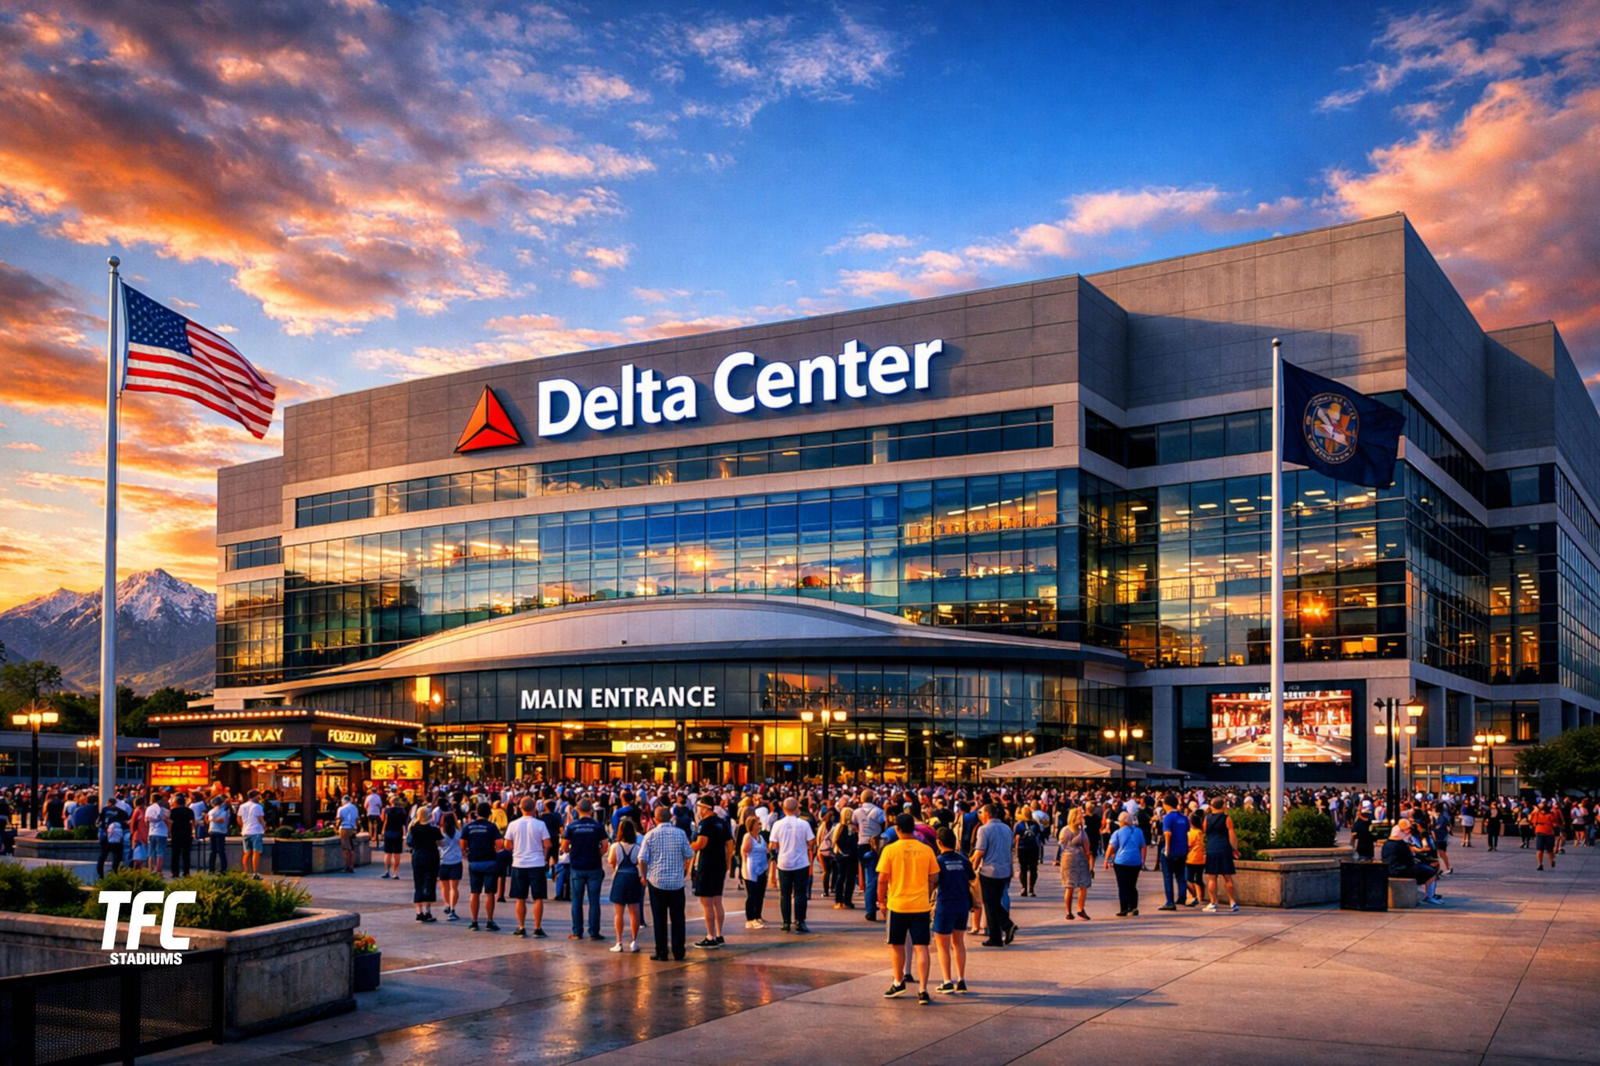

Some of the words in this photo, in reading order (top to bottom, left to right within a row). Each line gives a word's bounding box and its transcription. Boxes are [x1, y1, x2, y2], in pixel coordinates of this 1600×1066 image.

[538, 364, 697, 437] Delta
[714, 339, 942, 413] Center
[520, 688, 582, 709] MAIN
[591, 686, 716, 707] ENTRANCE
